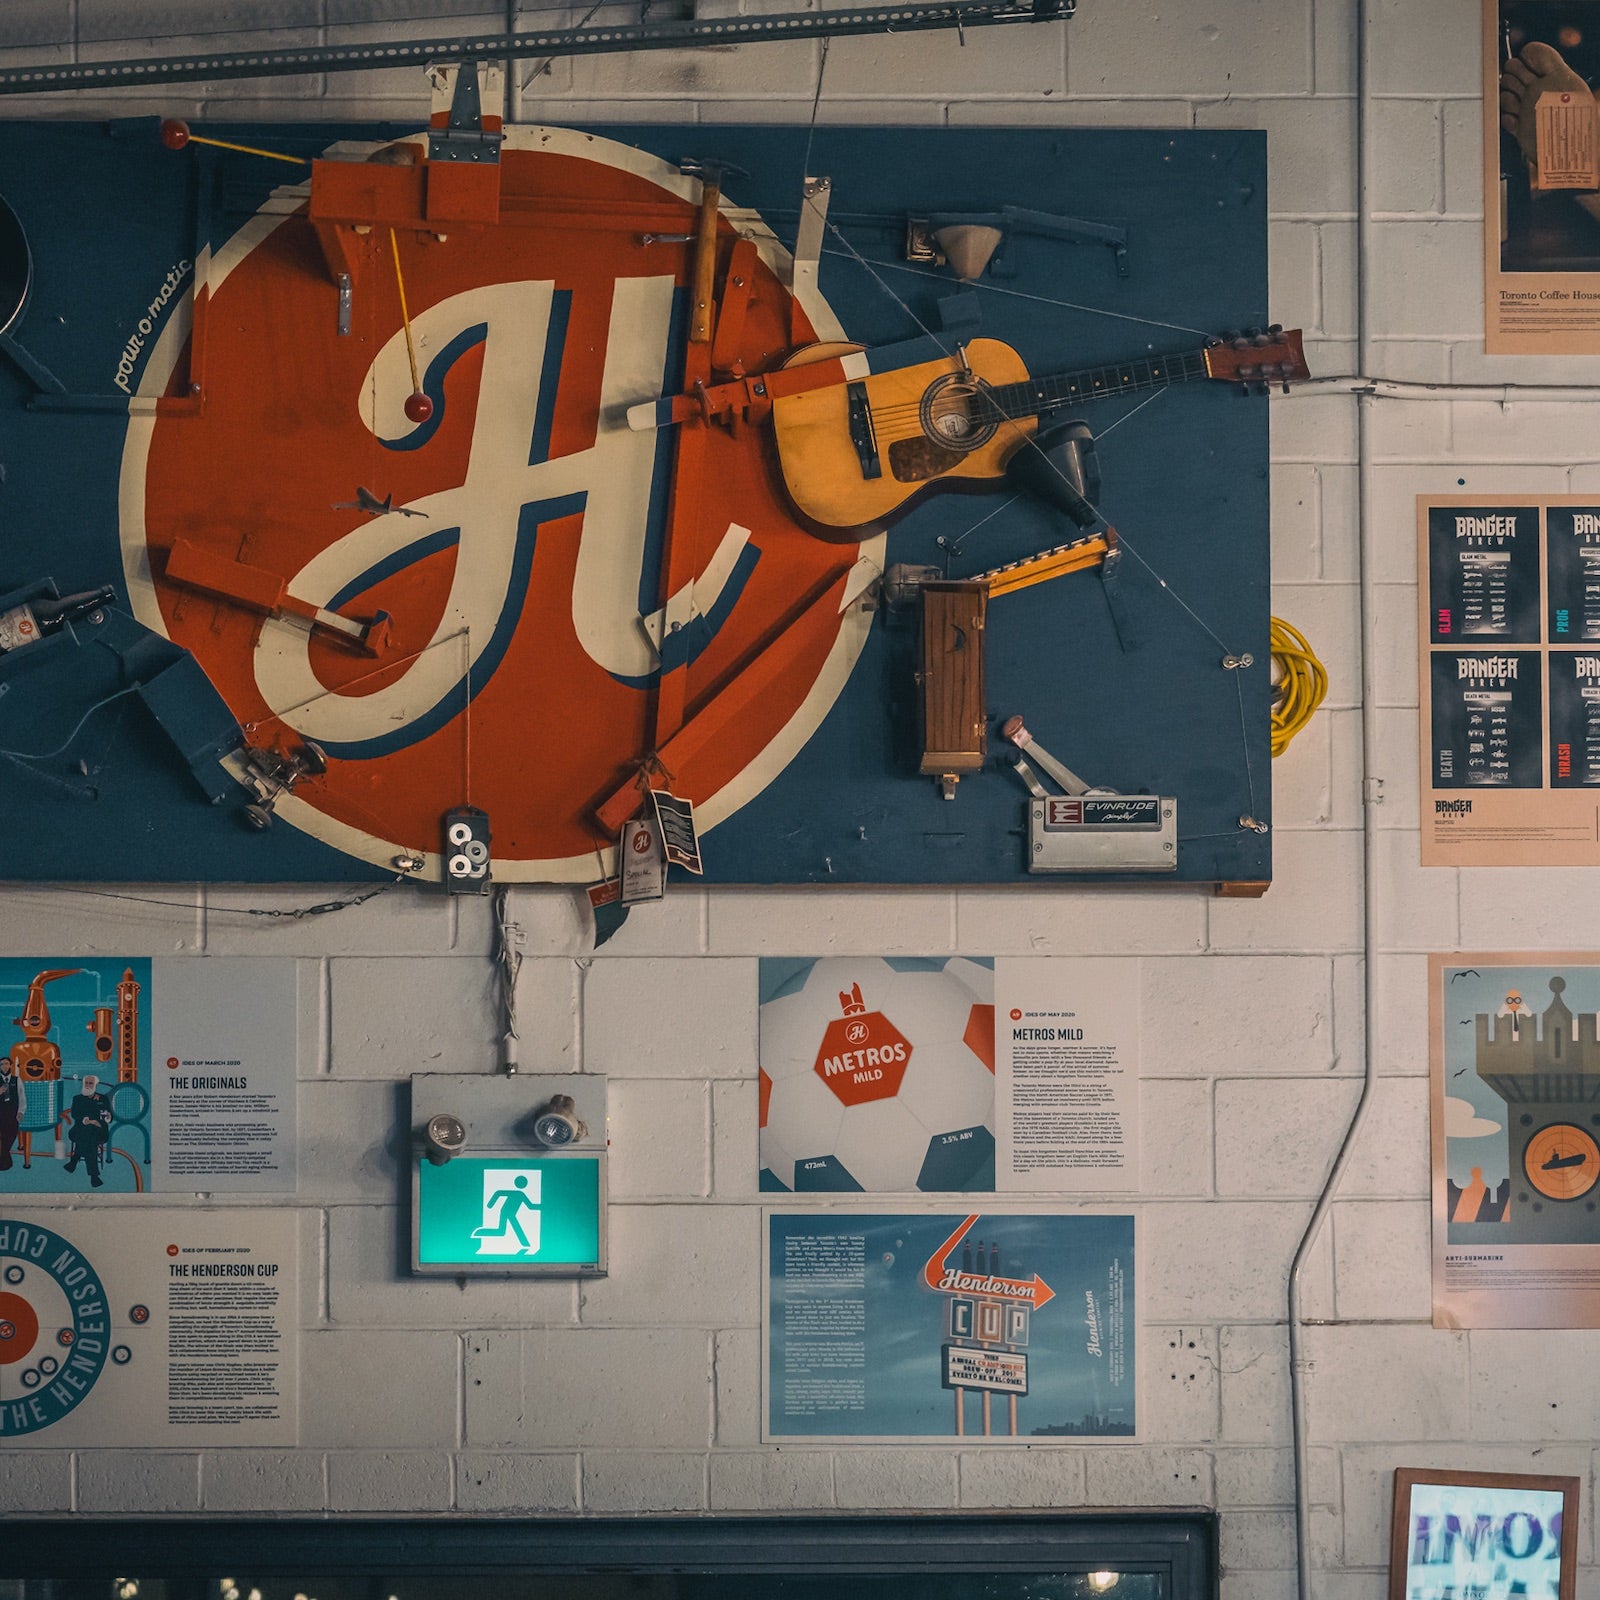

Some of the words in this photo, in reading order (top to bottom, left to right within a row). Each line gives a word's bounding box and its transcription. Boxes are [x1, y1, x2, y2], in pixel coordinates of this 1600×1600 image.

[1499, 290, 1537, 300] Toronto
[1539, 290, 1570, 300] Coffee
[252, 274, 751, 743] H
[1454, 514, 1517, 538] BANGER
[1467, 537, 1505, 546] BREW
[1438, 609, 1451, 634] GLAM
[1556, 609, 1569, 633] PROG
[1456, 655, 1520, 680] BANGER
[1470, 678, 1506, 687] BREW
[1440, 750, 1454, 778] DEATH
[1558, 743, 1571, 778] THRASH
[1085, 802, 1156, 811] EVINRUDE
[1434, 799, 1472, 814] BANGER
[1013, 1028, 1055, 1040] METROS
[1057, 1028, 1084, 1040] MILD
[823, 1043, 907, 1077] METROS
[169, 1076, 189, 1089] THE
[192, 1076, 247, 1089] ORIGINALS
[853, 1070, 883, 1084] MILD
[942, 1135, 958, 1144] 3.5%
[959, 1132, 973, 1141] ABV
[169, 1264, 189, 1277] THE
[192, 1264, 254, 1277] HENDERSON
[257, 1264, 279, 1277] CUP
[939, 1268, 1036, 1298] Henderson
[50, 1250, 104, 1407] HENDERSON
[955, 1304, 1025, 1338] CUP
[1084, 1290, 1102, 1358] Henderson
[952, 1357, 976, 1366] ANNUAL
[952, 1372, 988, 1381] EVERYONE
